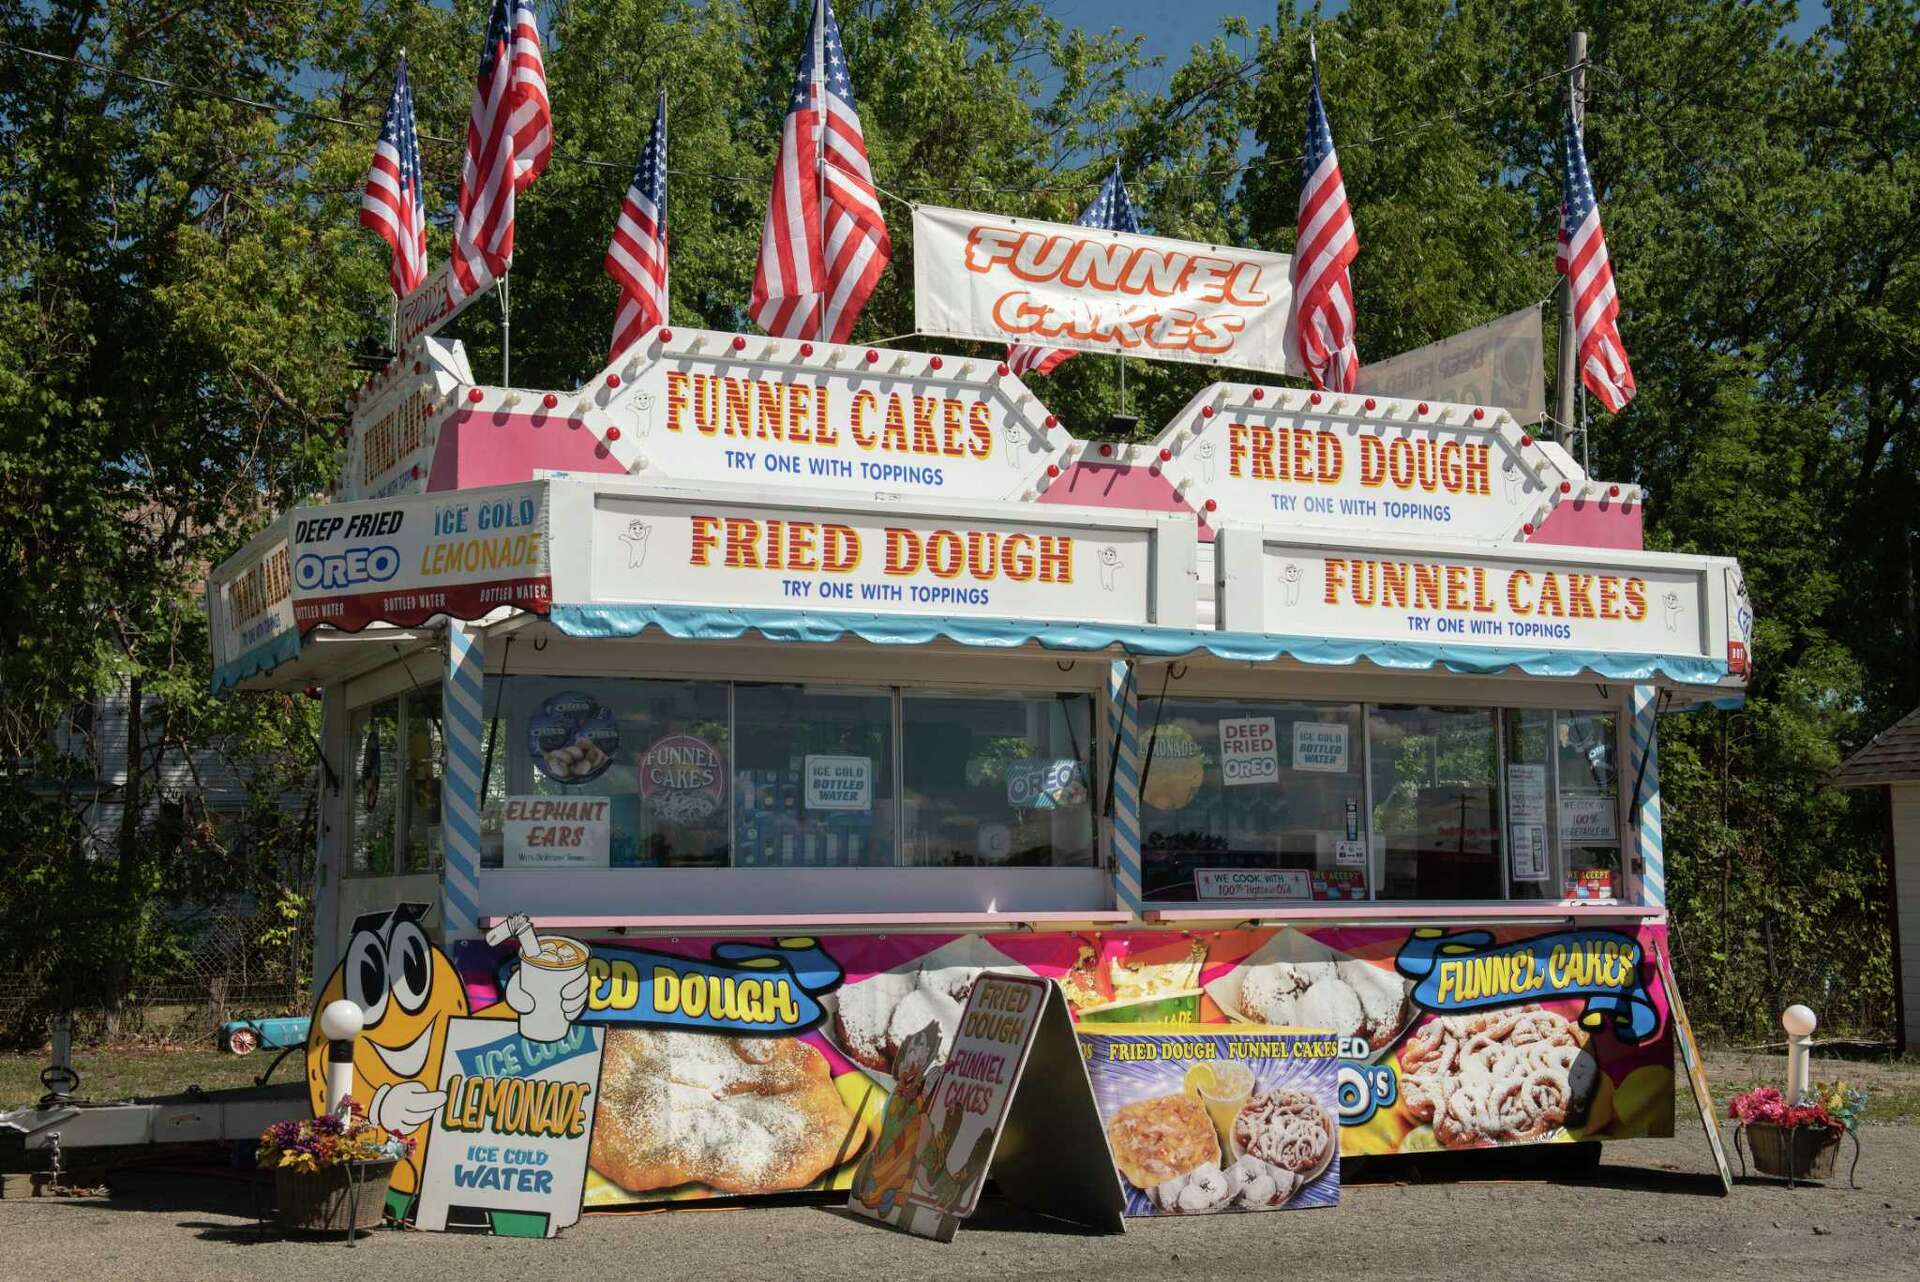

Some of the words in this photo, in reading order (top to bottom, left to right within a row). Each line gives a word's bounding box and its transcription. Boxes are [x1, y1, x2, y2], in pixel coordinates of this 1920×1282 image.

[965, 226, 1270, 308] FUNNEL
[993, 291, 1245, 354] CAKES
[666, 370, 840, 447] FUNNEL
[850, 388, 993, 461] CAKES
[725, 450, 757, 470] TRY
[764, 453, 801, 473] ONE
[808, 458, 852, 477] WITH
[860, 462, 944, 486] TOPPINGS
[1228, 423, 1344, 484] FRIED
[1359, 434, 1492, 496] DOUGH
[434, 503, 469, 537] ICE
[478, 495, 535, 531] COLD
[1271, 494, 1297, 511] TRY
[1304, 496, 1334, 514] ONE
[1340, 499, 1376, 517] WITH
[1383, 501, 1451, 522] TOPPINGS
[295, 517, 344, 544] DEEP
[344, 510, 404, 539] FRIED
[420, 532, 543, 576] LEMONADE
[689, 515, 862, 574] FRIED
[882, 526, 1075, 584] DOUGH
[295, 545, 400, 590] OREO
[384, 596, 416, 612] BOTTLED
[419, 593, 446, 609] WATER
[480, 587, 512, 603] BOTTLED
[516, 584, 547, 599] WATER
[782, 579, 811, 598] TRY
[819, 581, 854, 600] ONE
[861, 583, 902, 601] WITH
[910, 585, 989, 605] TOPPINGS
[1324, 558, 1496, 614] FUNNEL
[1506, 569, 1648, 623] CAKES
[295, 606, 319, 620] OTTLED
[322, 602, 344, 617] WATER
[1407, 616, 1431, 632] TRY
[1437, 617, 1465, 634] ONE
[1470, 619, 1502, 636] WITH
[1508, 621, 1571, 639] TOPPINGS
[1225, 723, 1270, 739] DEEP
[647, 747, 718, 768] FUNNEL
[1139, 738, 1195, 757] LONADE
[1223, 738, 1274, 754] FRIED
[1299, 743, 1342, 754] BOTTLED
[1304, 754, 1337, 764] WATER
[650, 768, 715, 789] CAKES
[813, 766, 832, 777] ICE
[835, 767, 864, 777] COLD
[1224, 756, 1277, 778] OREO
[813, 779, 864, 790] BOTTLED
[818, 790, 858, 801] WATER
[1008, 764, 1074, 804] OREO
[505, 800, 609, 821] ELEPHANT
[527, 826, 585, 847] EARS
[1214, 873, 1229, 883] WE
[1232, 873, 1261, 883] COOK
[1265, 873, 1285, 883] WITH
[1328, 871, 1360, 881] ACCEPT
[1218, 884, 1244, 896] 100%
[1437, 948, 1545, 1005] FUNNEL
[1548, 939, 1636, 990] CAKES
[653, 966, 800, 1024] DOUGH
[978, 982, 1032, 1013] FRIED
[964, 1011, 1027, 1046] DOUGH
[474, 1045, 523, 1079] ICE
[1109, 1042, 1158, 1061] FRIED
[1161, 1041, 1217, 1061] DOUGH
[1228, 1040, 1289, 1059] FUNNEL
[1293, 1040, 1338, 1059] CAKES
[950, 1050, 1007, 1085] FUNNEL
[441, 1074, 591, 1140] LEMONADE
[943, 1080, 993, 1116] CAKES
[466, 1145, 500, 1162] ICE
[503, 1148, 549, 1166] COLD
[453, 1164, 554, 1194] WATER
